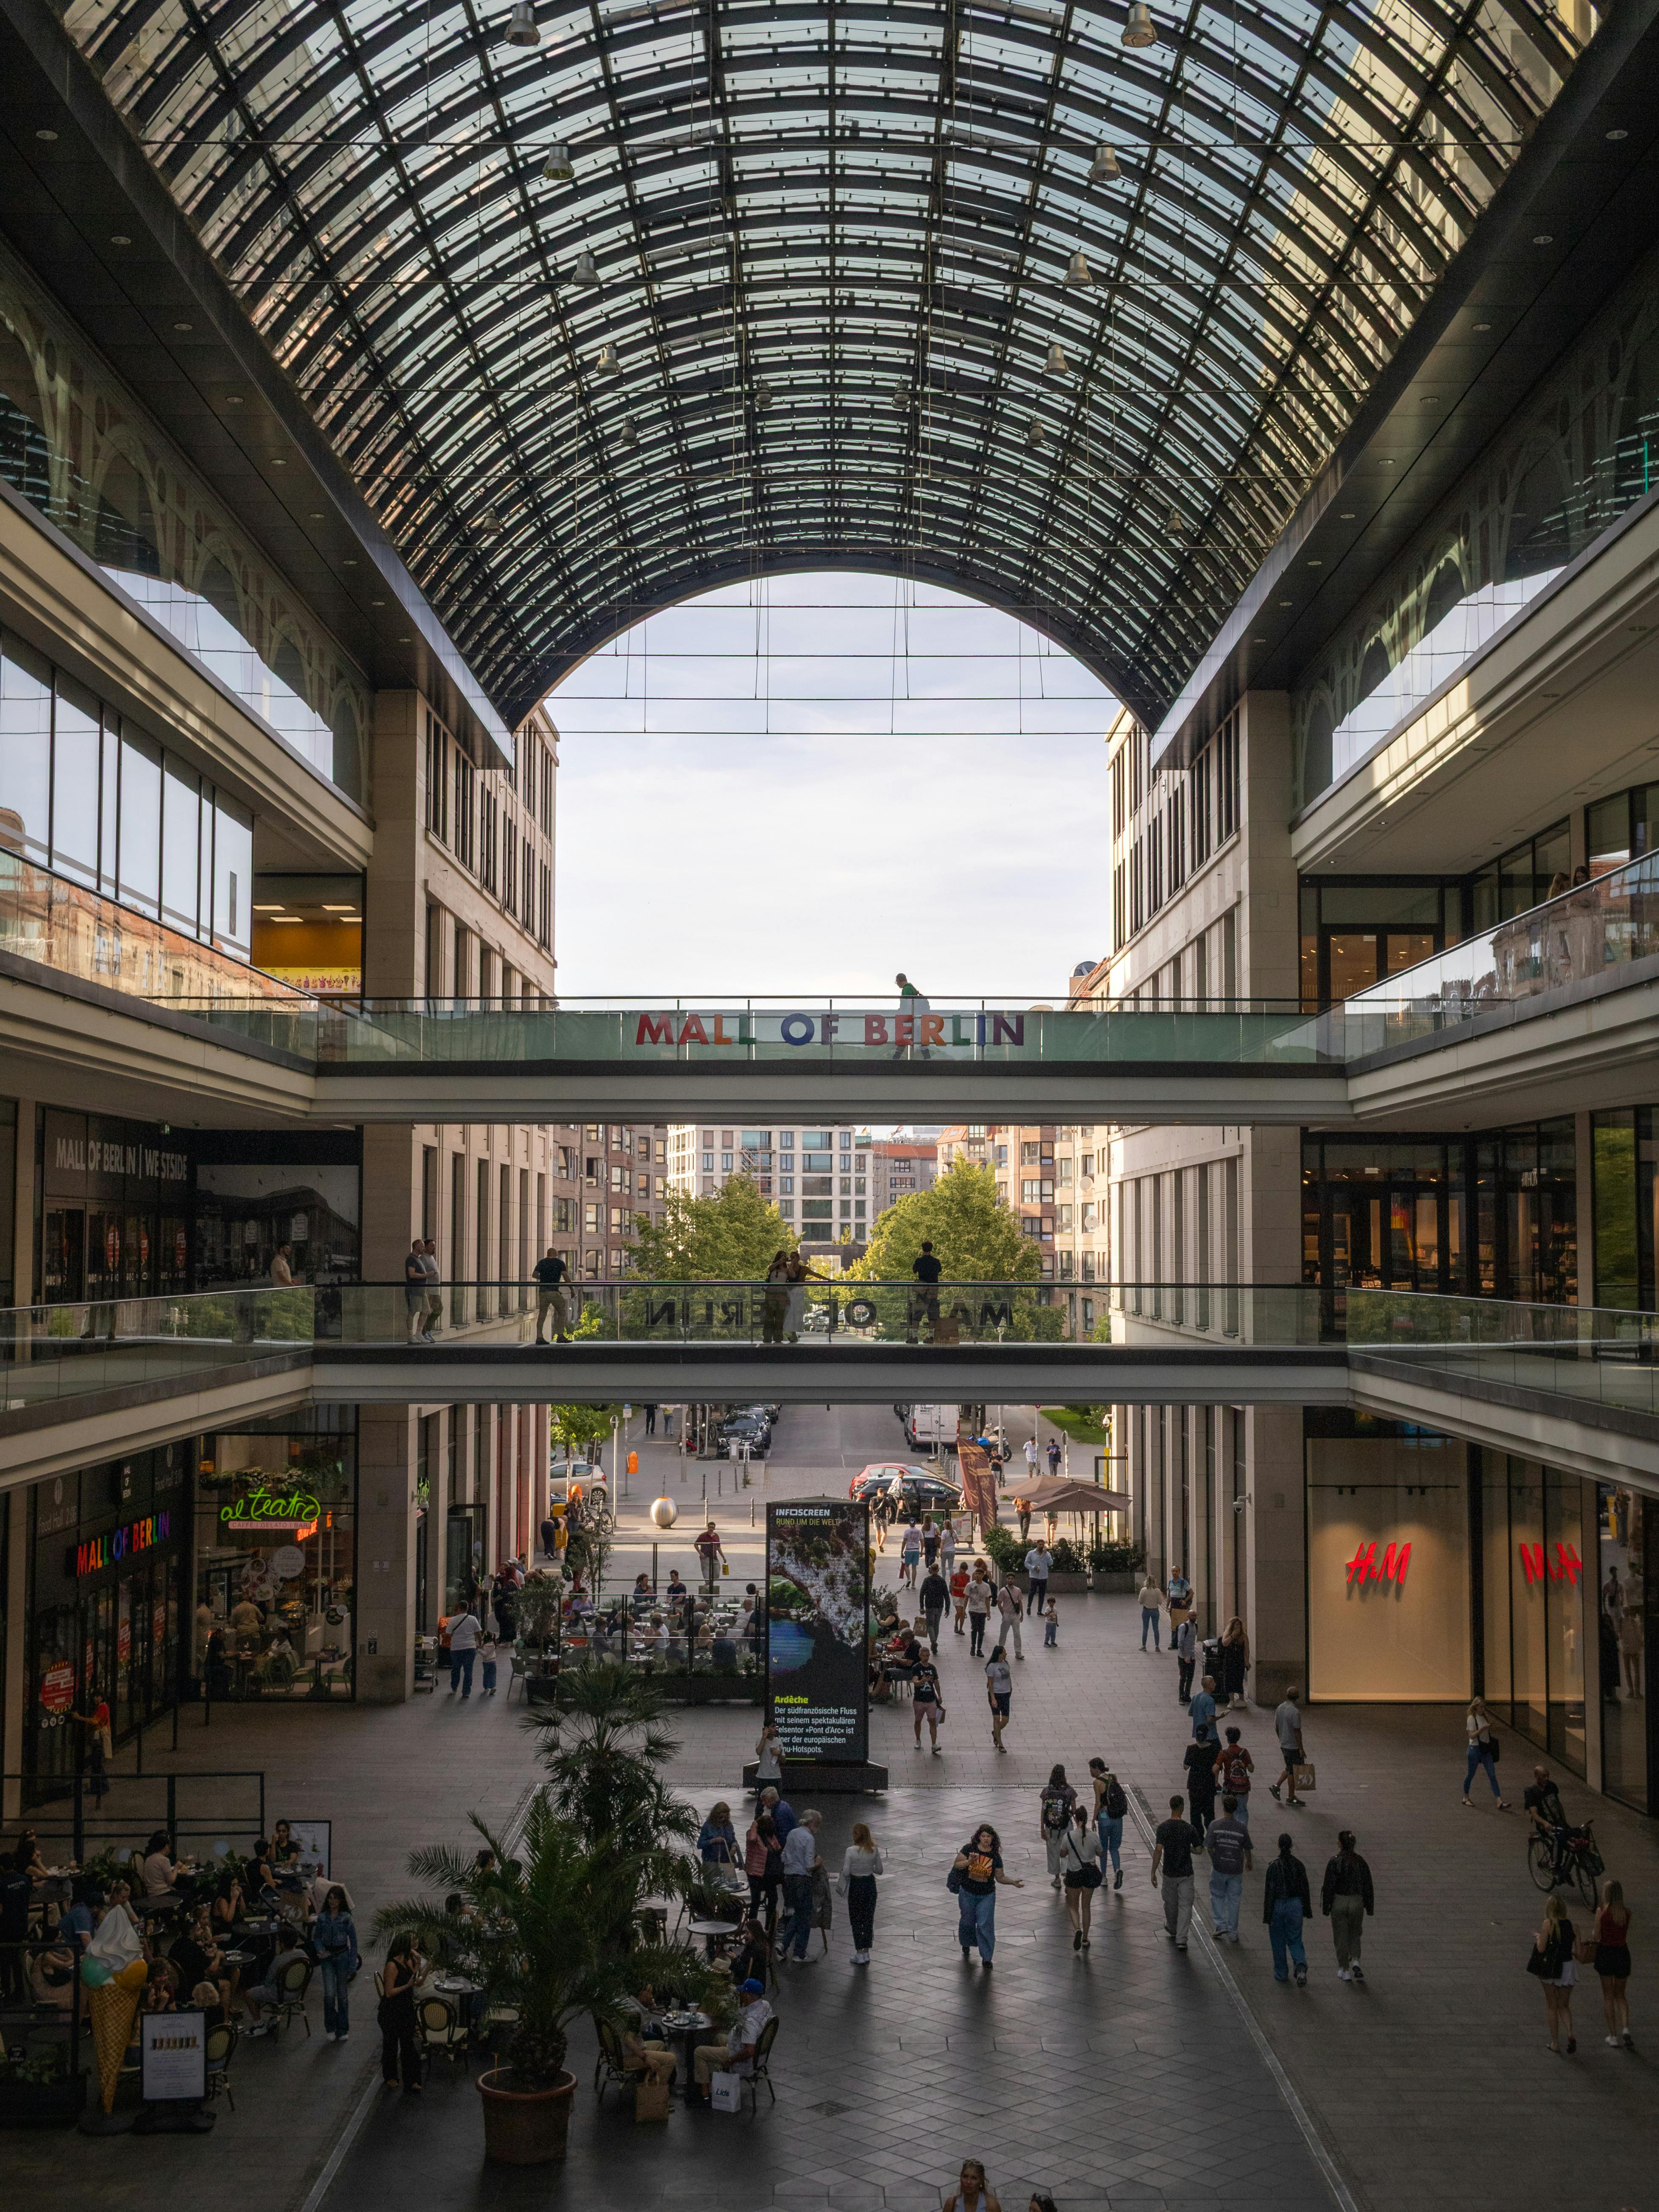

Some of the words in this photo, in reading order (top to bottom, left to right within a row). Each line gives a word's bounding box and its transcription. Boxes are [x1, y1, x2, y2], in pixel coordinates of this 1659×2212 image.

[635, 1013, 757, 1046] MALL
[781, 1013, 838, 1046] OF
[865, 1014, 1024, 1046] BERLIN
[56, 1138, 85, 1170] MALL
[88, 1140, 101, 1171] OF
[103, 1143, 136, 1174] BERLIN
[220, 1499, 250, 1521] al
[248, 1487, 321, 1521] teatro
[77, 1535, 109, 1578] MALL
[113, 1526, 129, 1561] OF
[132, 1510, 170, 1553] BERLIN
[1346, 1541, 1412, 1585] H&M
[774, 1695, 808, 1703] Ardèche
[787, 1706, 838, 1714] südfranzösische
[811, 1717, 855, 1725] spektakulären
[804, 1736, 846, 1745] europäischen
[783, 1745, 823, 1754] nu-Hotspots.
[716, 2088, 730, 2097] Lids
